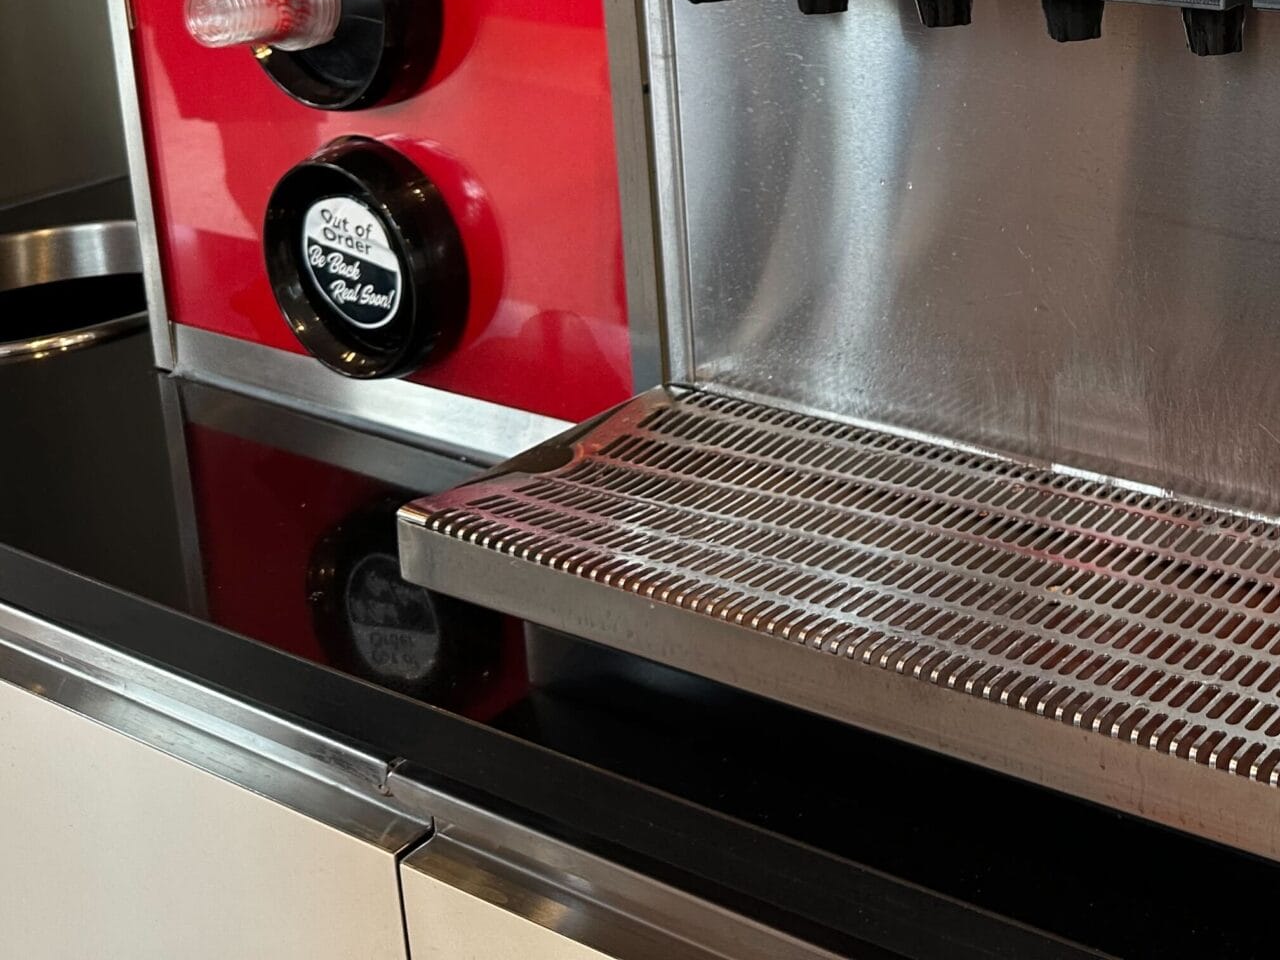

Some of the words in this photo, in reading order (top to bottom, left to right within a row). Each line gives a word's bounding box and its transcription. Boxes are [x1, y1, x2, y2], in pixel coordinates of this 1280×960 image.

[320, 208, 349, 232] Out
[355, 224, 374, 240] of
[322, 226, 373, 255] Order
[308, 244, 326, 268] Be
[327, 254, 361, 281] Back
[329, 279, 360, 305] Real
[360, 285, 395, 310] Soon!
